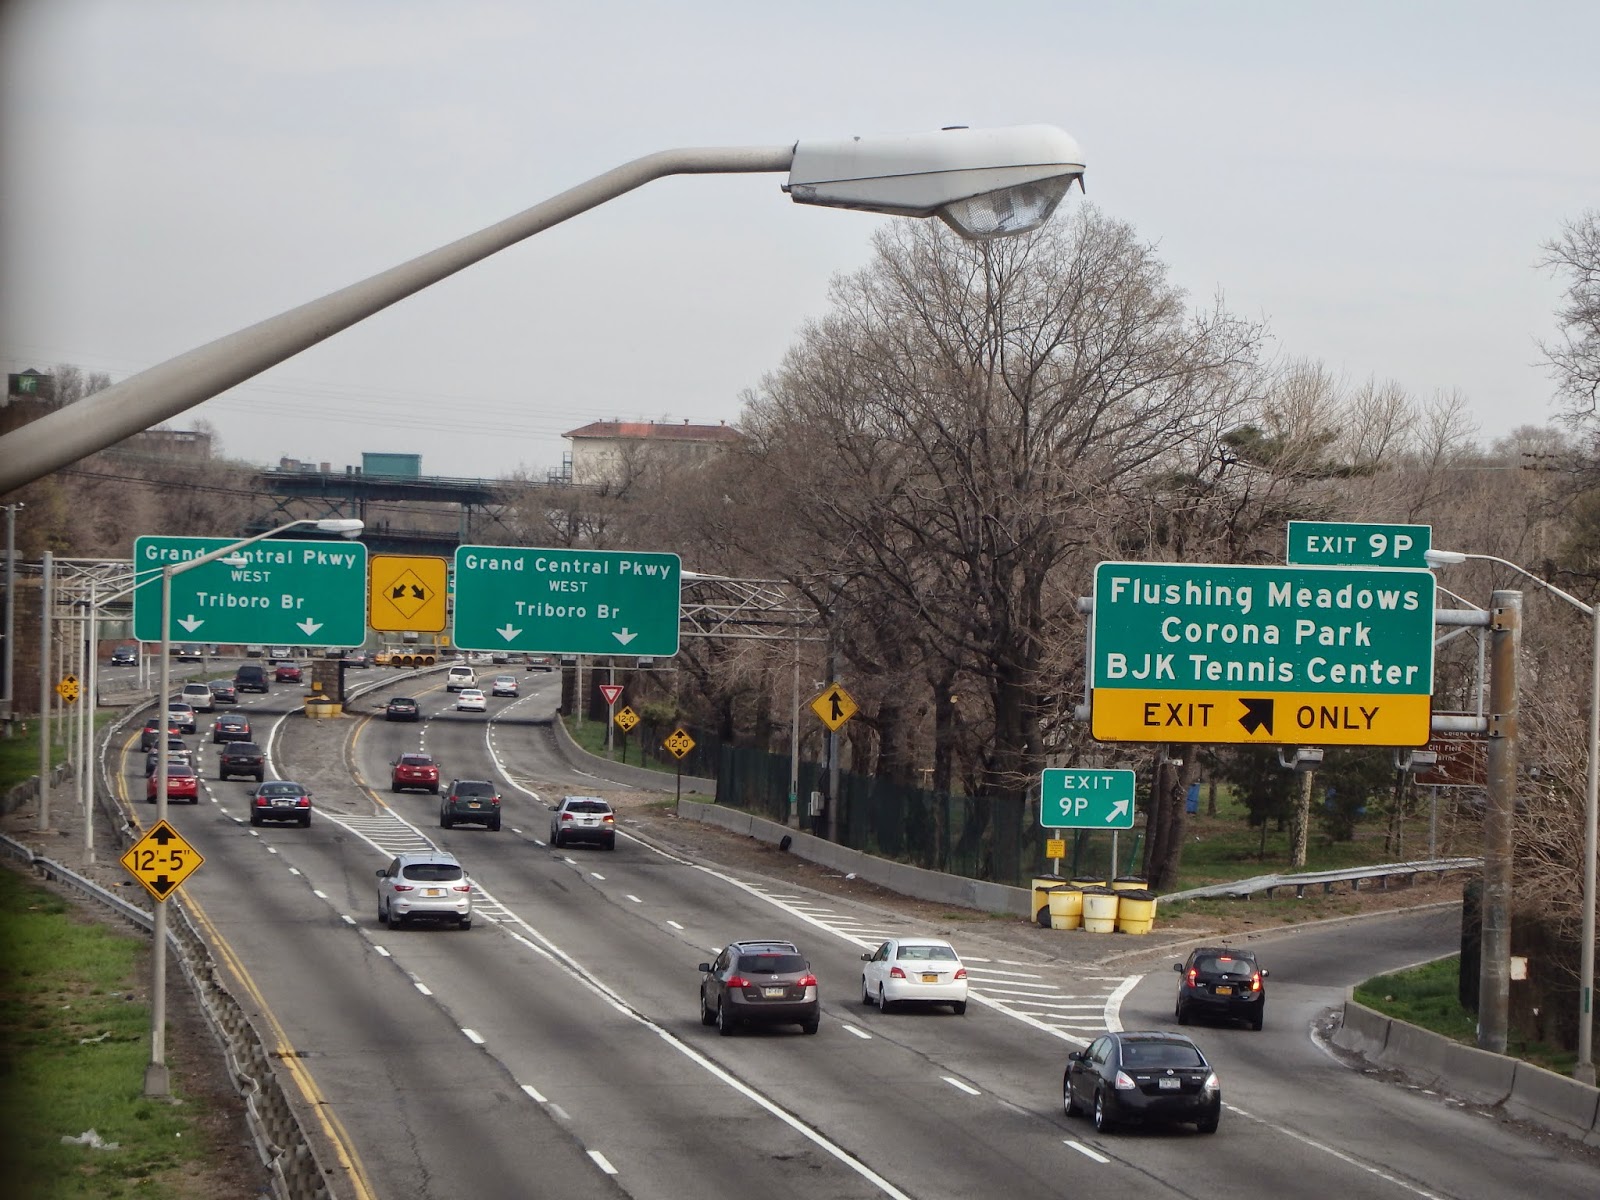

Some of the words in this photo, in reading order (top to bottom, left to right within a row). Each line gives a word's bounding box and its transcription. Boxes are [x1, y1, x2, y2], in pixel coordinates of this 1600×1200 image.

[145, 545, 205, 560] Grand
[233, 549, 292, 564] entral
[303, 550, 356, 568] Pkwy
[1307, 535, 1357, 554] EXIT
[1369, 533, 1413, 559] 9P
[231, 571, 271, 582] WEST
[465, 555, 524, 571] Grand
[535, 558, 608, 574] Central
[619, 561, 670, 579] Pkwy
[549, 580, 588, 592] WEST
[1110, 577, 1253, 614] Flushing
[1268, 581, 1419, 611] Meadows
[197, 592, 270, 608] Triboro
[281, 594, 304, 609] Br
[515, 601, 586, 617] Triboro
[597, 604, 619, 618] Br
[1161, 616, 1280, 644] Corona
[1295, 619, 1372, 647] Park
[1107, 653, 1176, 680] BJK
[1189, 654, 1294, 682] Tennis
[1307, 657, 1418, 686] Center
[1144, 703, 1214, 727] EXIT
[1297, 706, 1379, 729] ONLY
[1064, 776, 1114, 789] EXIT
[1059, 797, 1088, 817] 9P
[133, 850, 190, 871] 12'-5"
